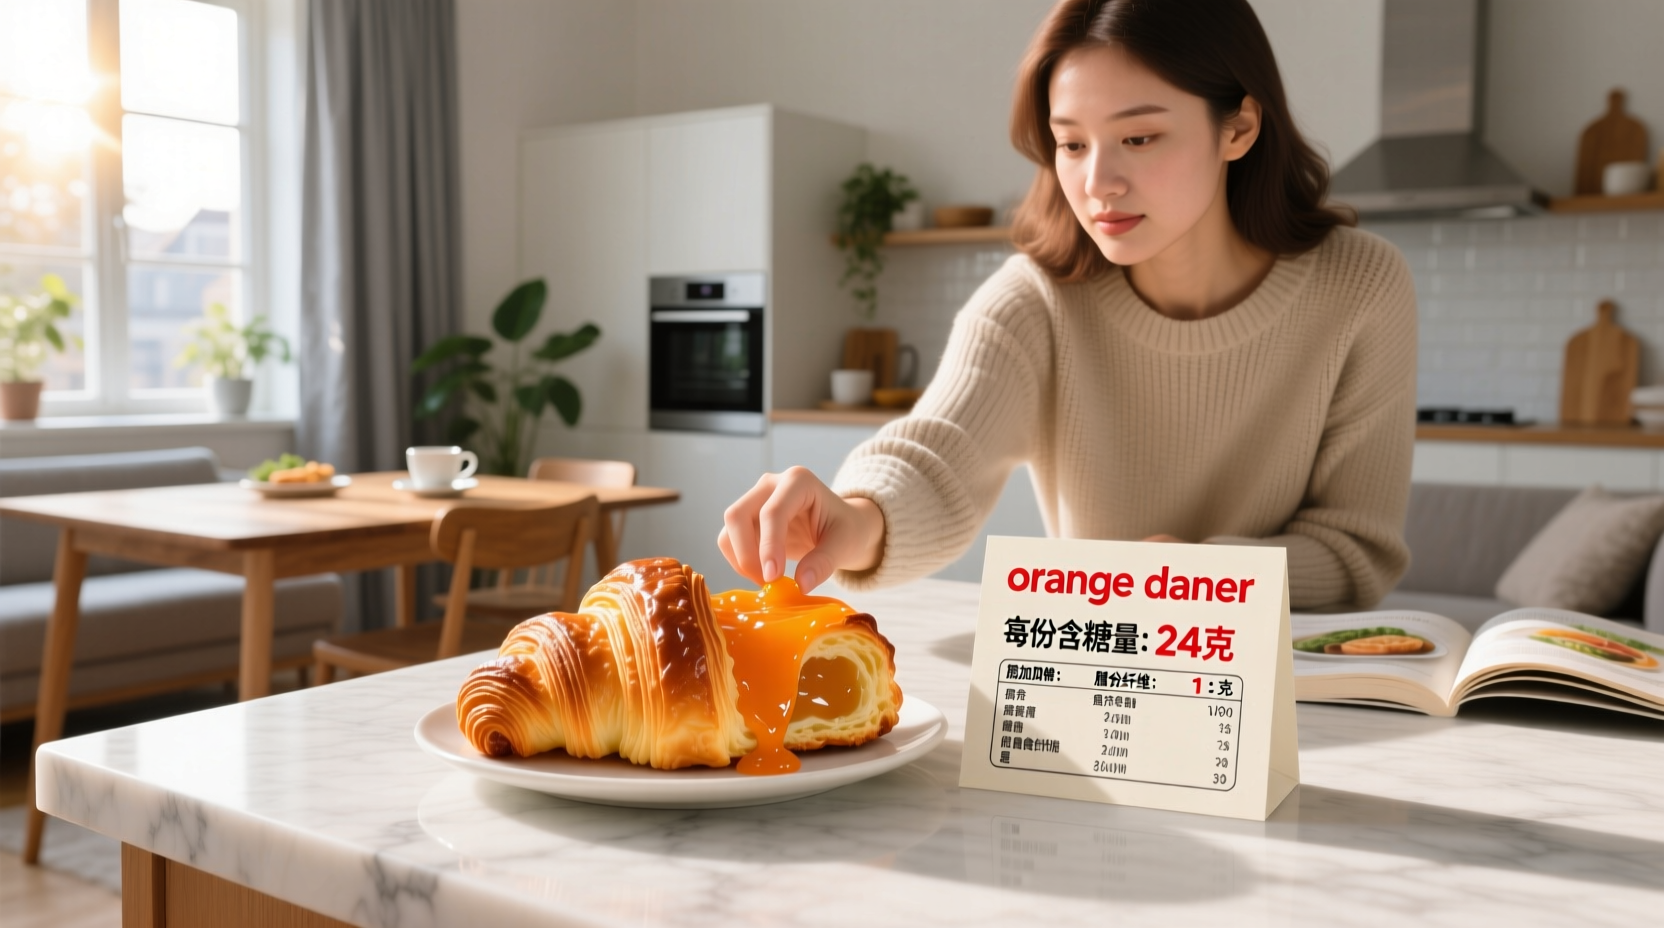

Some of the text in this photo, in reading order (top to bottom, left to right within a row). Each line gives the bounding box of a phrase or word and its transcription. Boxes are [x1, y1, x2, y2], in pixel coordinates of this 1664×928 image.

[1007, 566, 1255, 605] orange daner
[1155, 624, 1236, 662] 24克
[1213, 773, 1227, 785] 30
